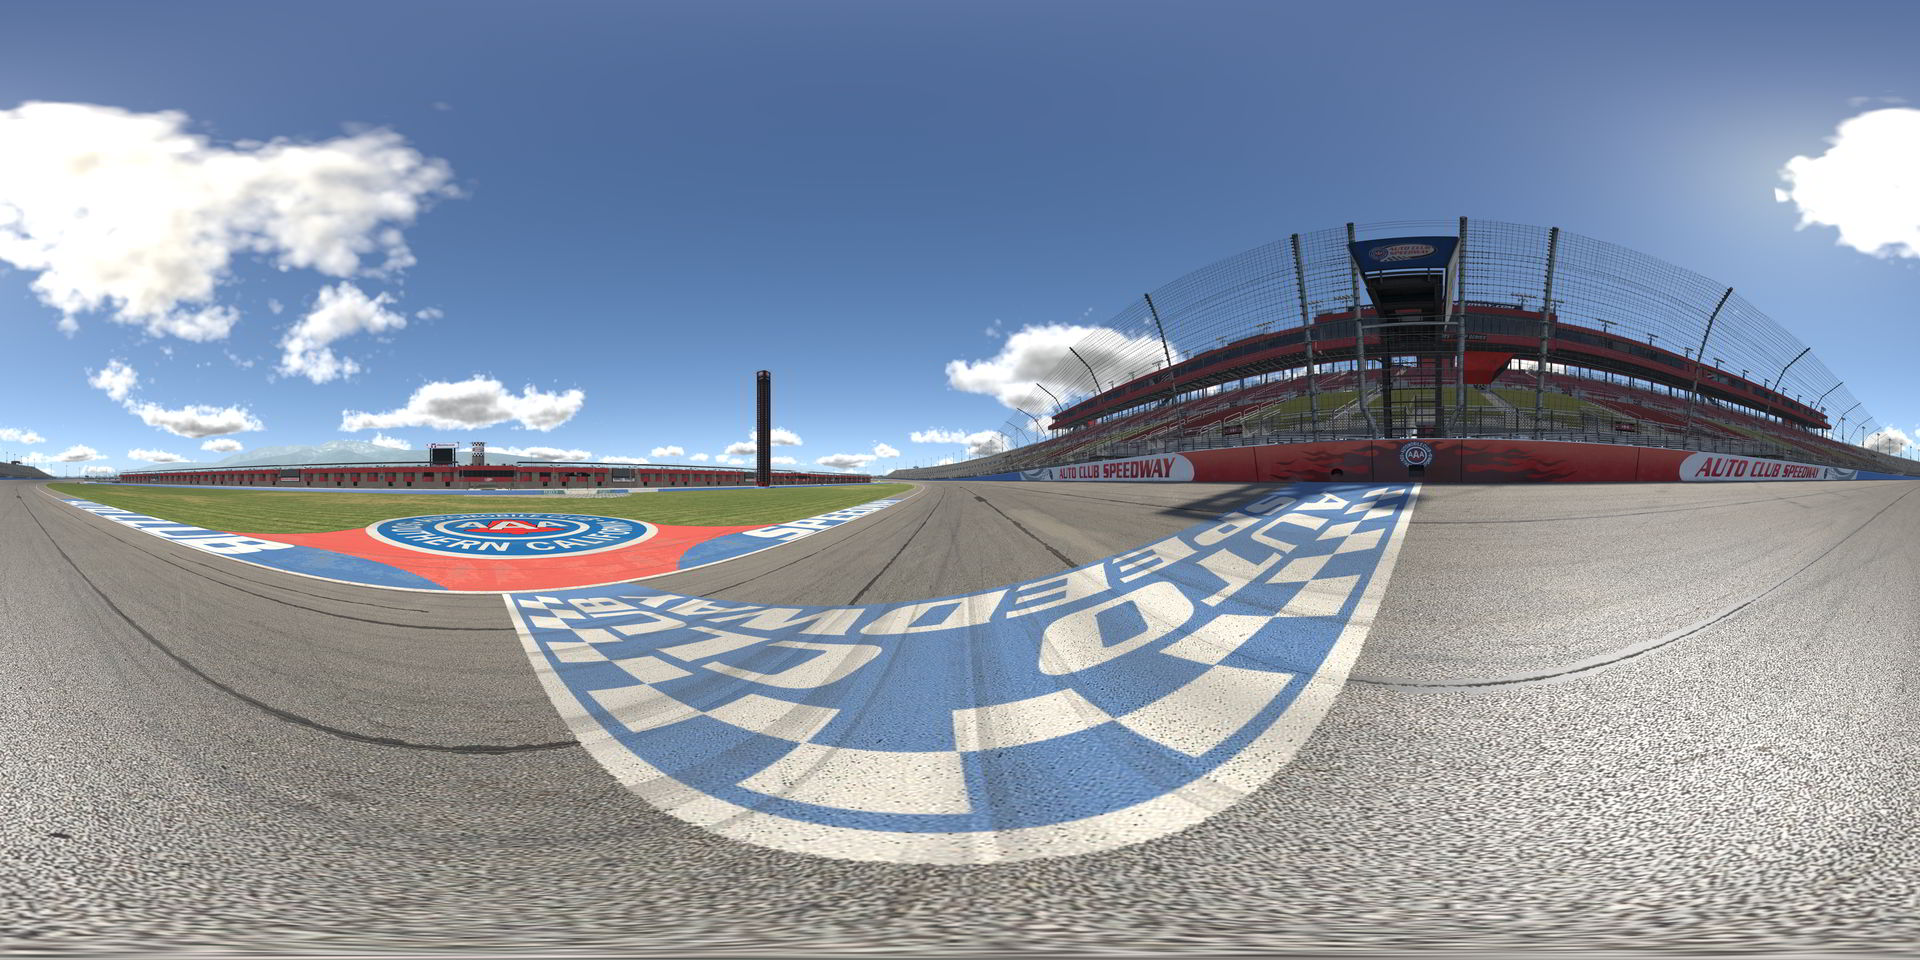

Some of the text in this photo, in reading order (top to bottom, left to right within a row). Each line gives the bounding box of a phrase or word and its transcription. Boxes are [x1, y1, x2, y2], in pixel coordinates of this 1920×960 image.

[1408, 450, 1425, 459] AAA
[1059, 457, 1176, 479] AUTO CLUB SPEEDWAY
[1695, 457, 1820, 478] AUTO CLUB SPEEDWAY
[455, 520, 569, 530] AAA
[618, 495, 1297, 636] SPEEDWAY
[568, 491, 1351, 689] AUTO CLUB
